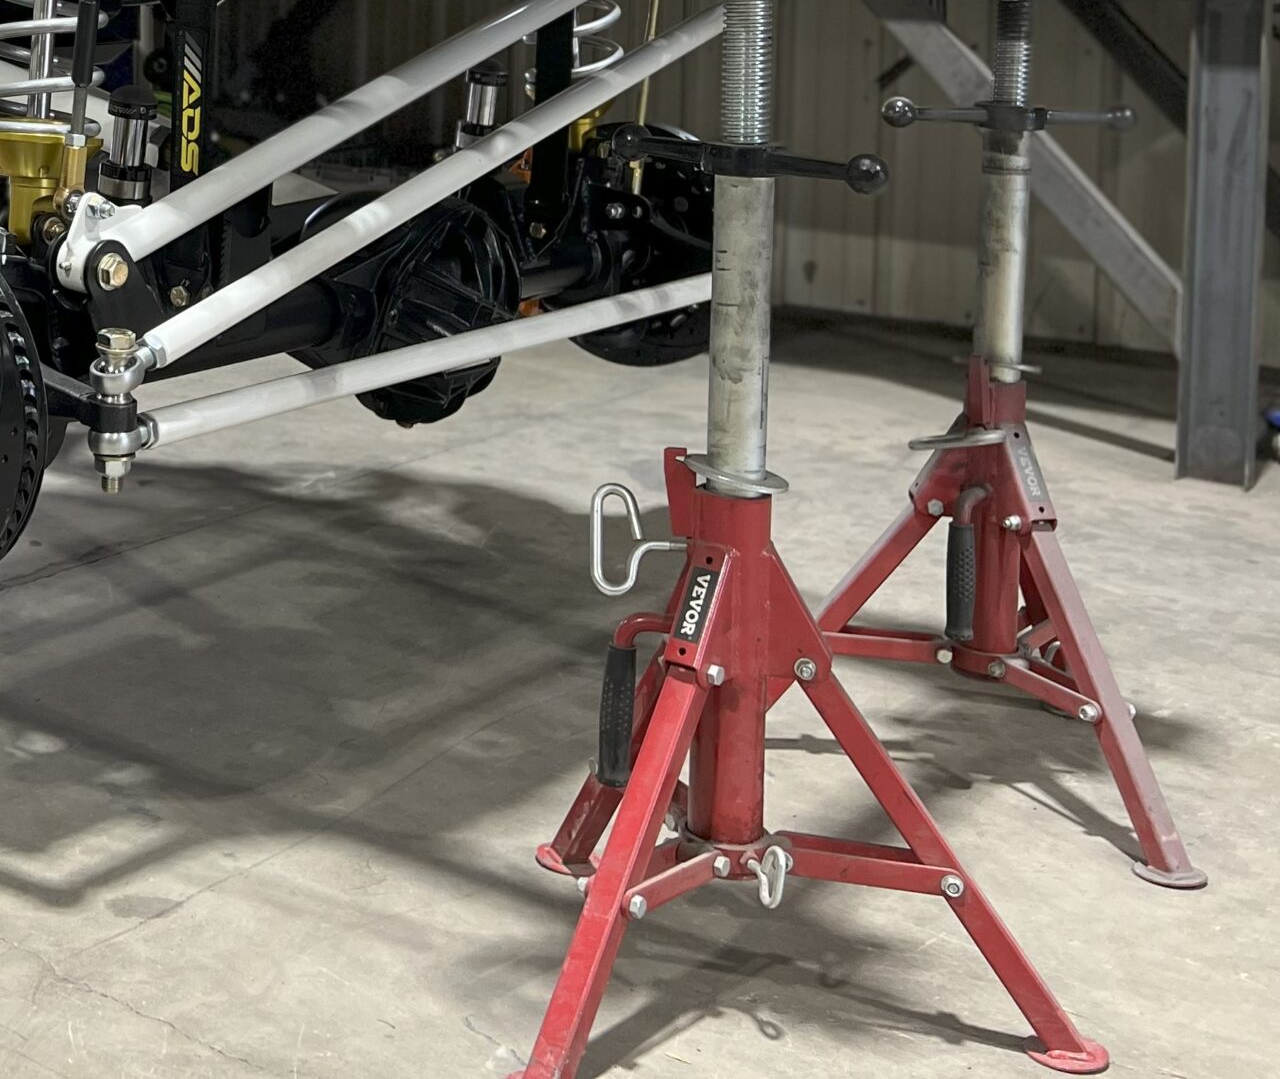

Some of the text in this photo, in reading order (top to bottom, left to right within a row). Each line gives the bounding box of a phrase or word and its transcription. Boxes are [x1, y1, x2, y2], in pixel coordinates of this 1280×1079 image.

[180, 68, 202, 176] ADS
[1018, 447, 1041, 497] VEVOR
[681, 574, 711, 638] VEVOR
